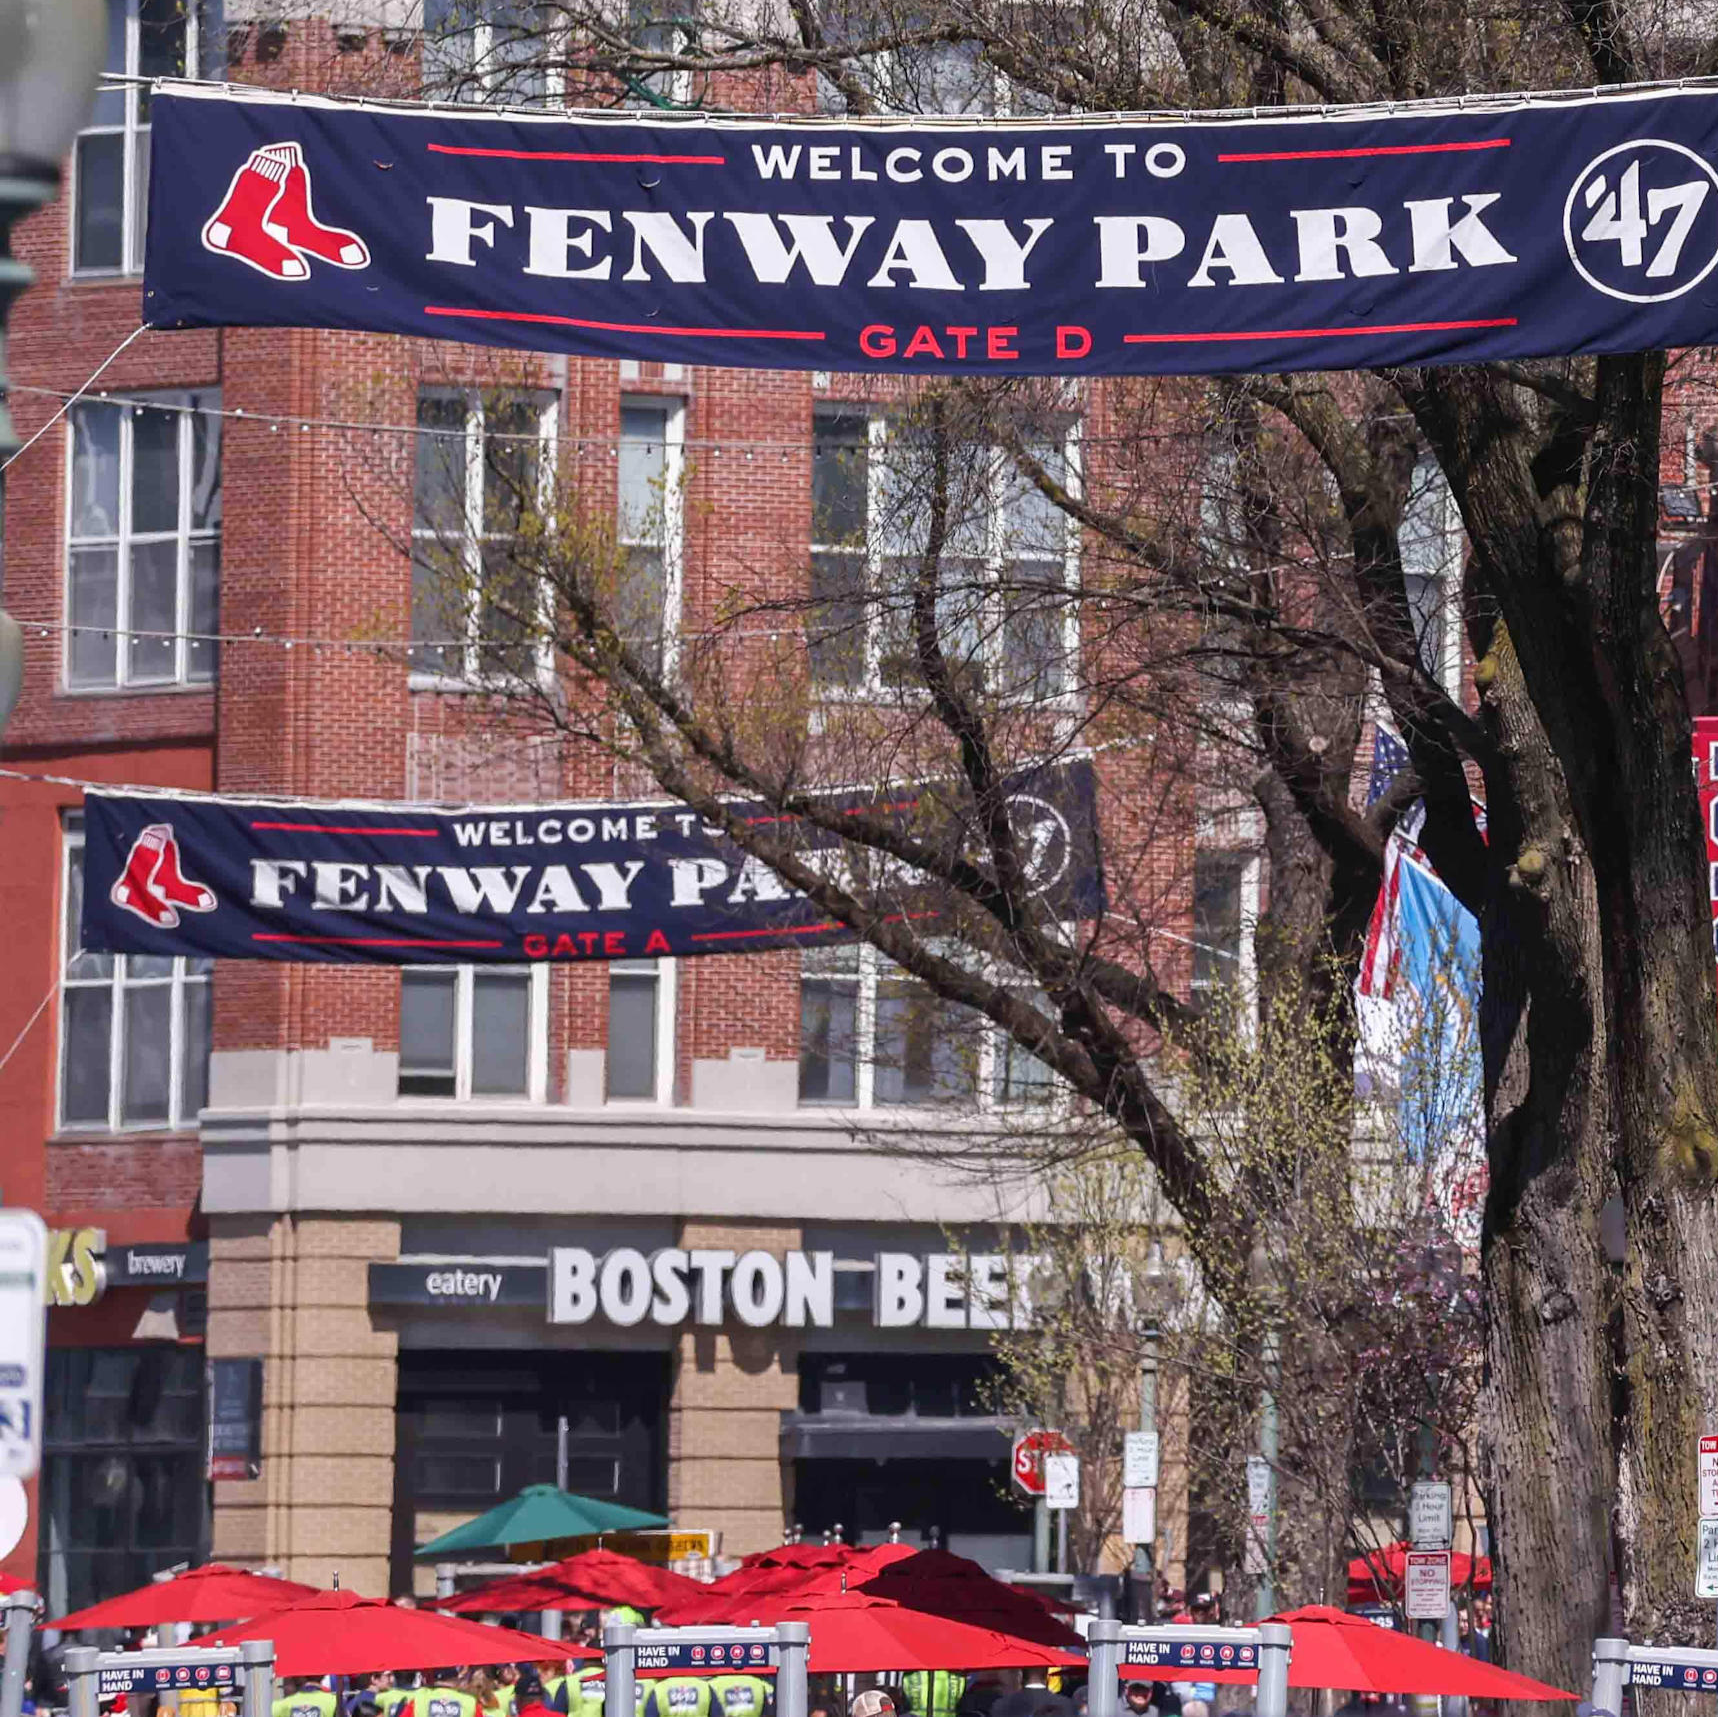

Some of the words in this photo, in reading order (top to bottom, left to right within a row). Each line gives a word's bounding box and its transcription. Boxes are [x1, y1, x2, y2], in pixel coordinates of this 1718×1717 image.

[751, 143, 1074, 183] WELCOME
[1104, 142, 1187, 179] TO
[427, 195, 1055, 291] FENWAY
[1093, 192, 1518, 288] PARK
[859, 324, 1020, 359] GATE
[1056, 325, 1093, 359] D
[453, 815, 658, 848] WELCOME
[250, 858, 646, 914] FENWAY
[523, 932, 626, 958] GATE
[645, 929, 672, 954] A
[127, 1250, 186, 1278] brewery
[426, 1270, 503, 1301] eatery
[549, 1246, 834, 1326] BOSTON
[1701, 1440, 1717, 1451] TOW
[1418, 1514, 1440, 1523] Limit
[1704, 1539, 1710, 1549] 2
[1419, 1569, 1435, 1578] NO
[638, 1646, 666, 1656] HAVE
[668, 1645, 680, 1656] IN
[1129, 1642, 1156, 1653] HAVE
[1159, 1643, 1170, 1654] IN
[638, 1656, 668, 1667] HAND
[1128, 1653, 1158, 1664] HAND
[102, 1669, 131, 1681] HAVE
[132, 1668, 144, 1679] IN
[1633, 1663, 1661, 1675] HAVE
[1662, 1665, 1674, 1676] IN
[102, 1680, 133, 1692] HAND
[1632, 1674, 1662, 1686] HAND
